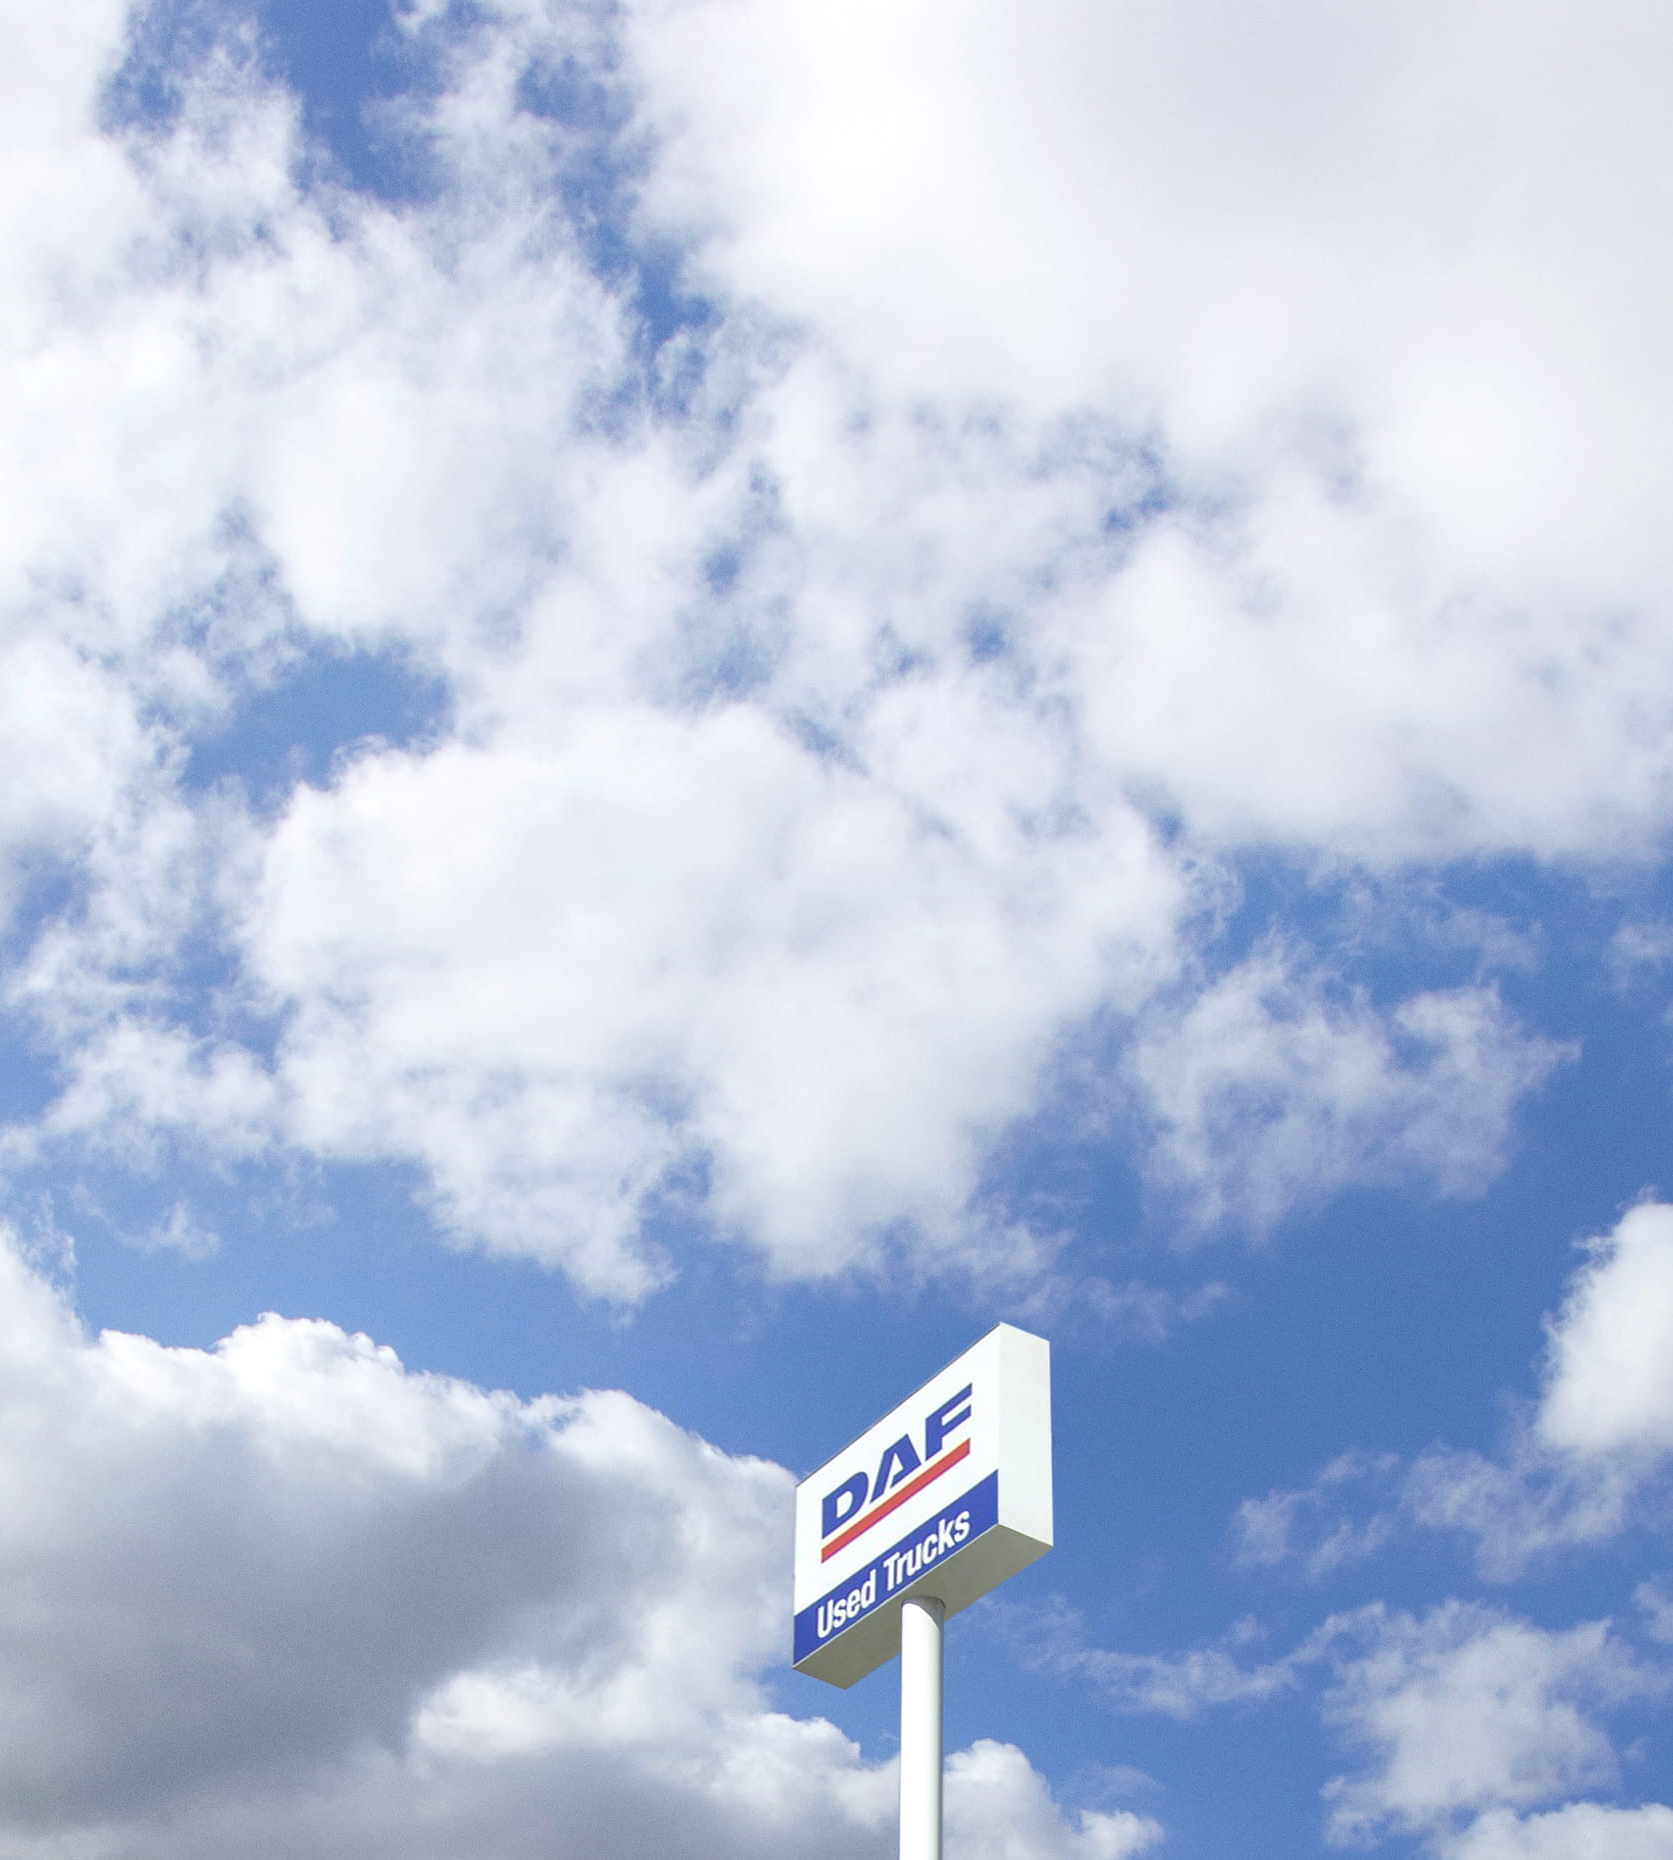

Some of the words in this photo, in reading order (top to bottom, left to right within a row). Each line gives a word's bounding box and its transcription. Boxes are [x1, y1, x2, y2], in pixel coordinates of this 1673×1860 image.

[821, 1382, 973, 1540] DAF
[816, 1573, 877, 1639] Used
[882, 1510, 971, 1592] Trucks
